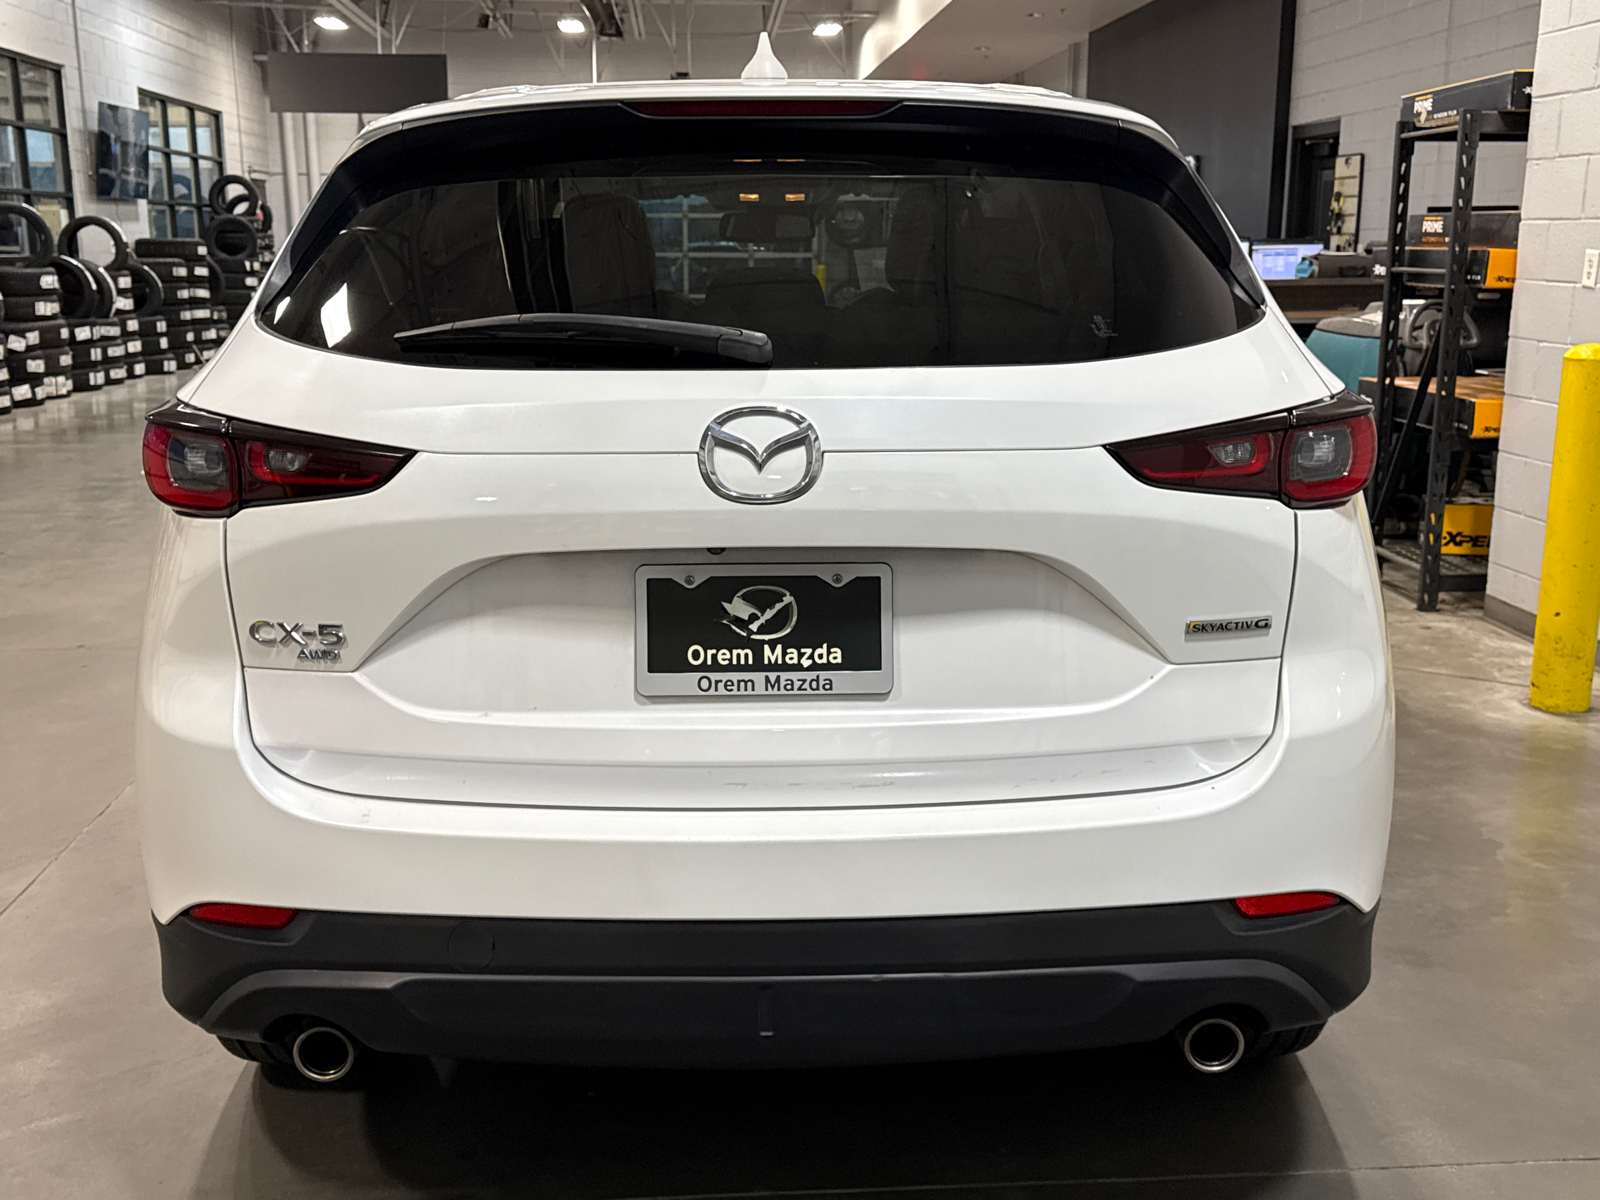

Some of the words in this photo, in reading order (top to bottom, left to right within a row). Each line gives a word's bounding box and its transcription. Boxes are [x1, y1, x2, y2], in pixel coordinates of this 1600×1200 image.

[1422, 220, 1445, 233] PRIME
[249, 620, 347, 646] CX-5
[687, 644, 754, 666] Orem
[763, 643, 843, 666] Mazda
[697, 675, 756, 693] Orem
[764, 674, 834, 692] Mazda
